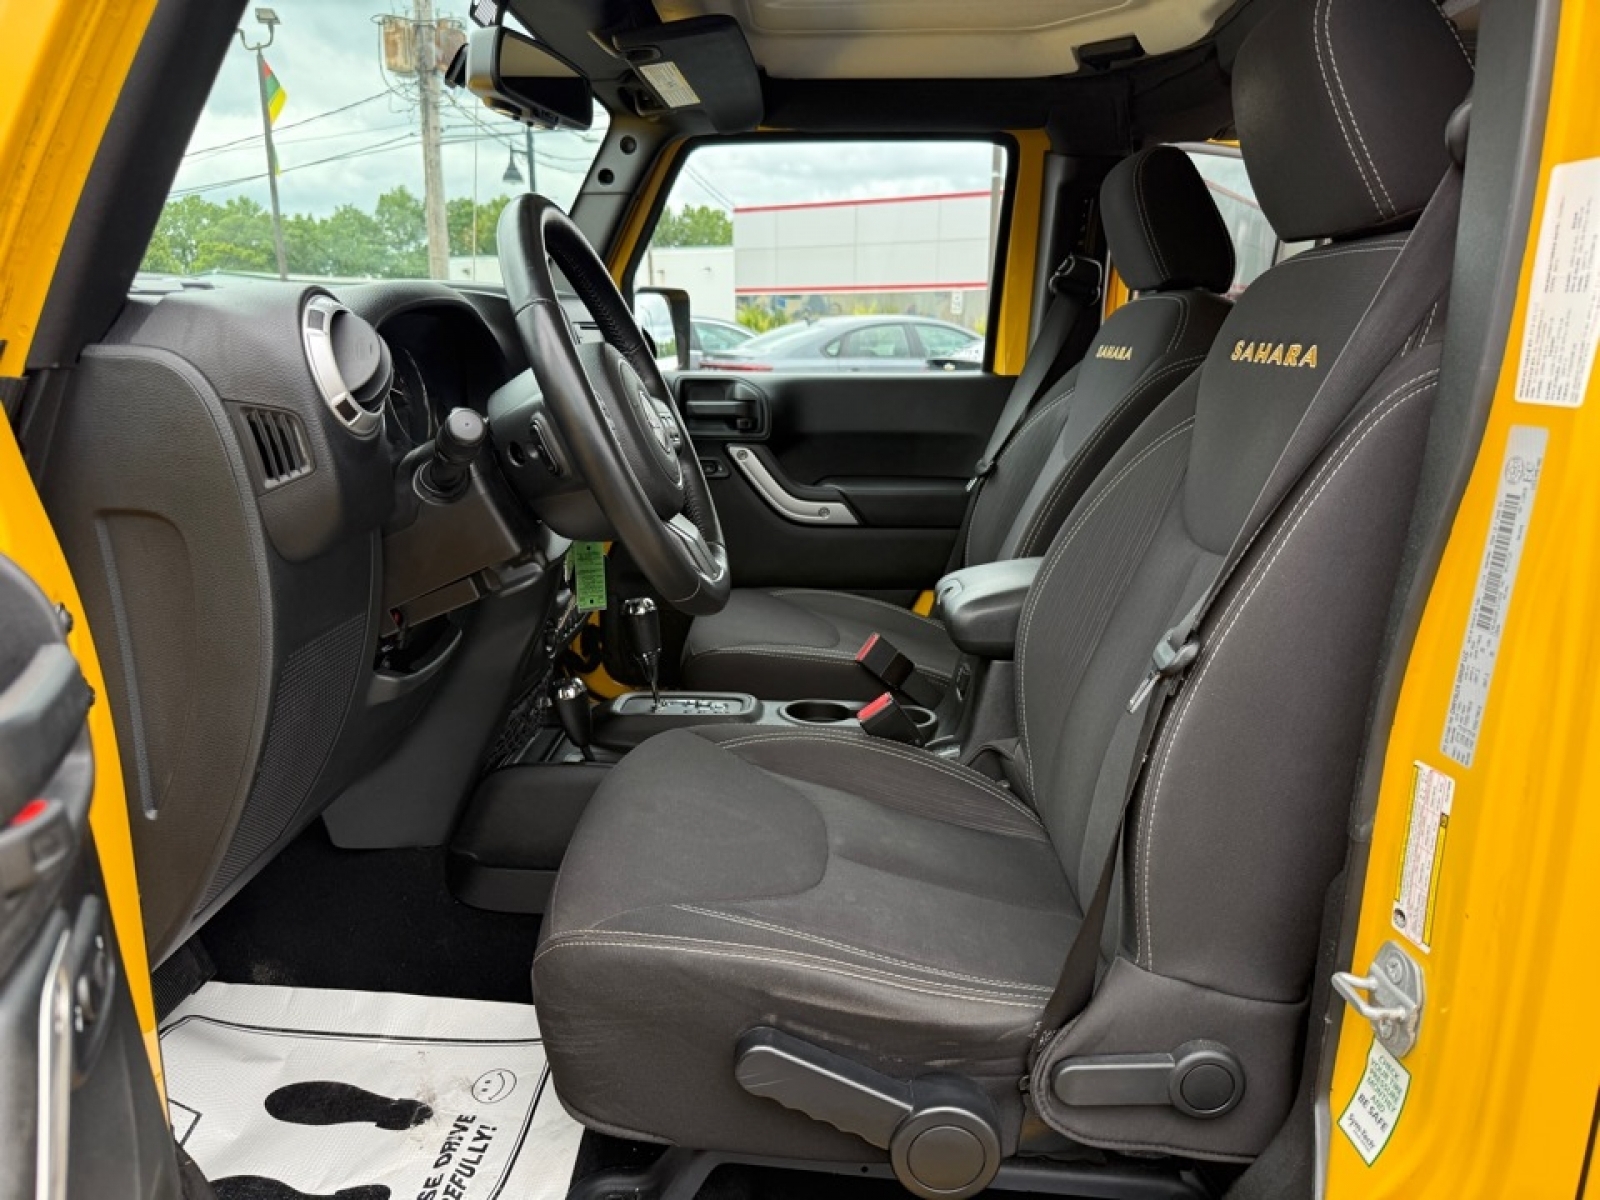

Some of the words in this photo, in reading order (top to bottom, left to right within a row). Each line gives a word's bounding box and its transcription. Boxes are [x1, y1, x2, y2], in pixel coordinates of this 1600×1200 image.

[1095, 345, 1133, 361] SAHARA
[1230, 339, 1318, 368] SAHARA
[1358, 1093, 1370, 1108] BE
[1368, 1106, 1388, 1133] SAFE
[433, 1114, 477, 1168] DRIVE
[442, 1125, 497, 1200] EFULLY!
